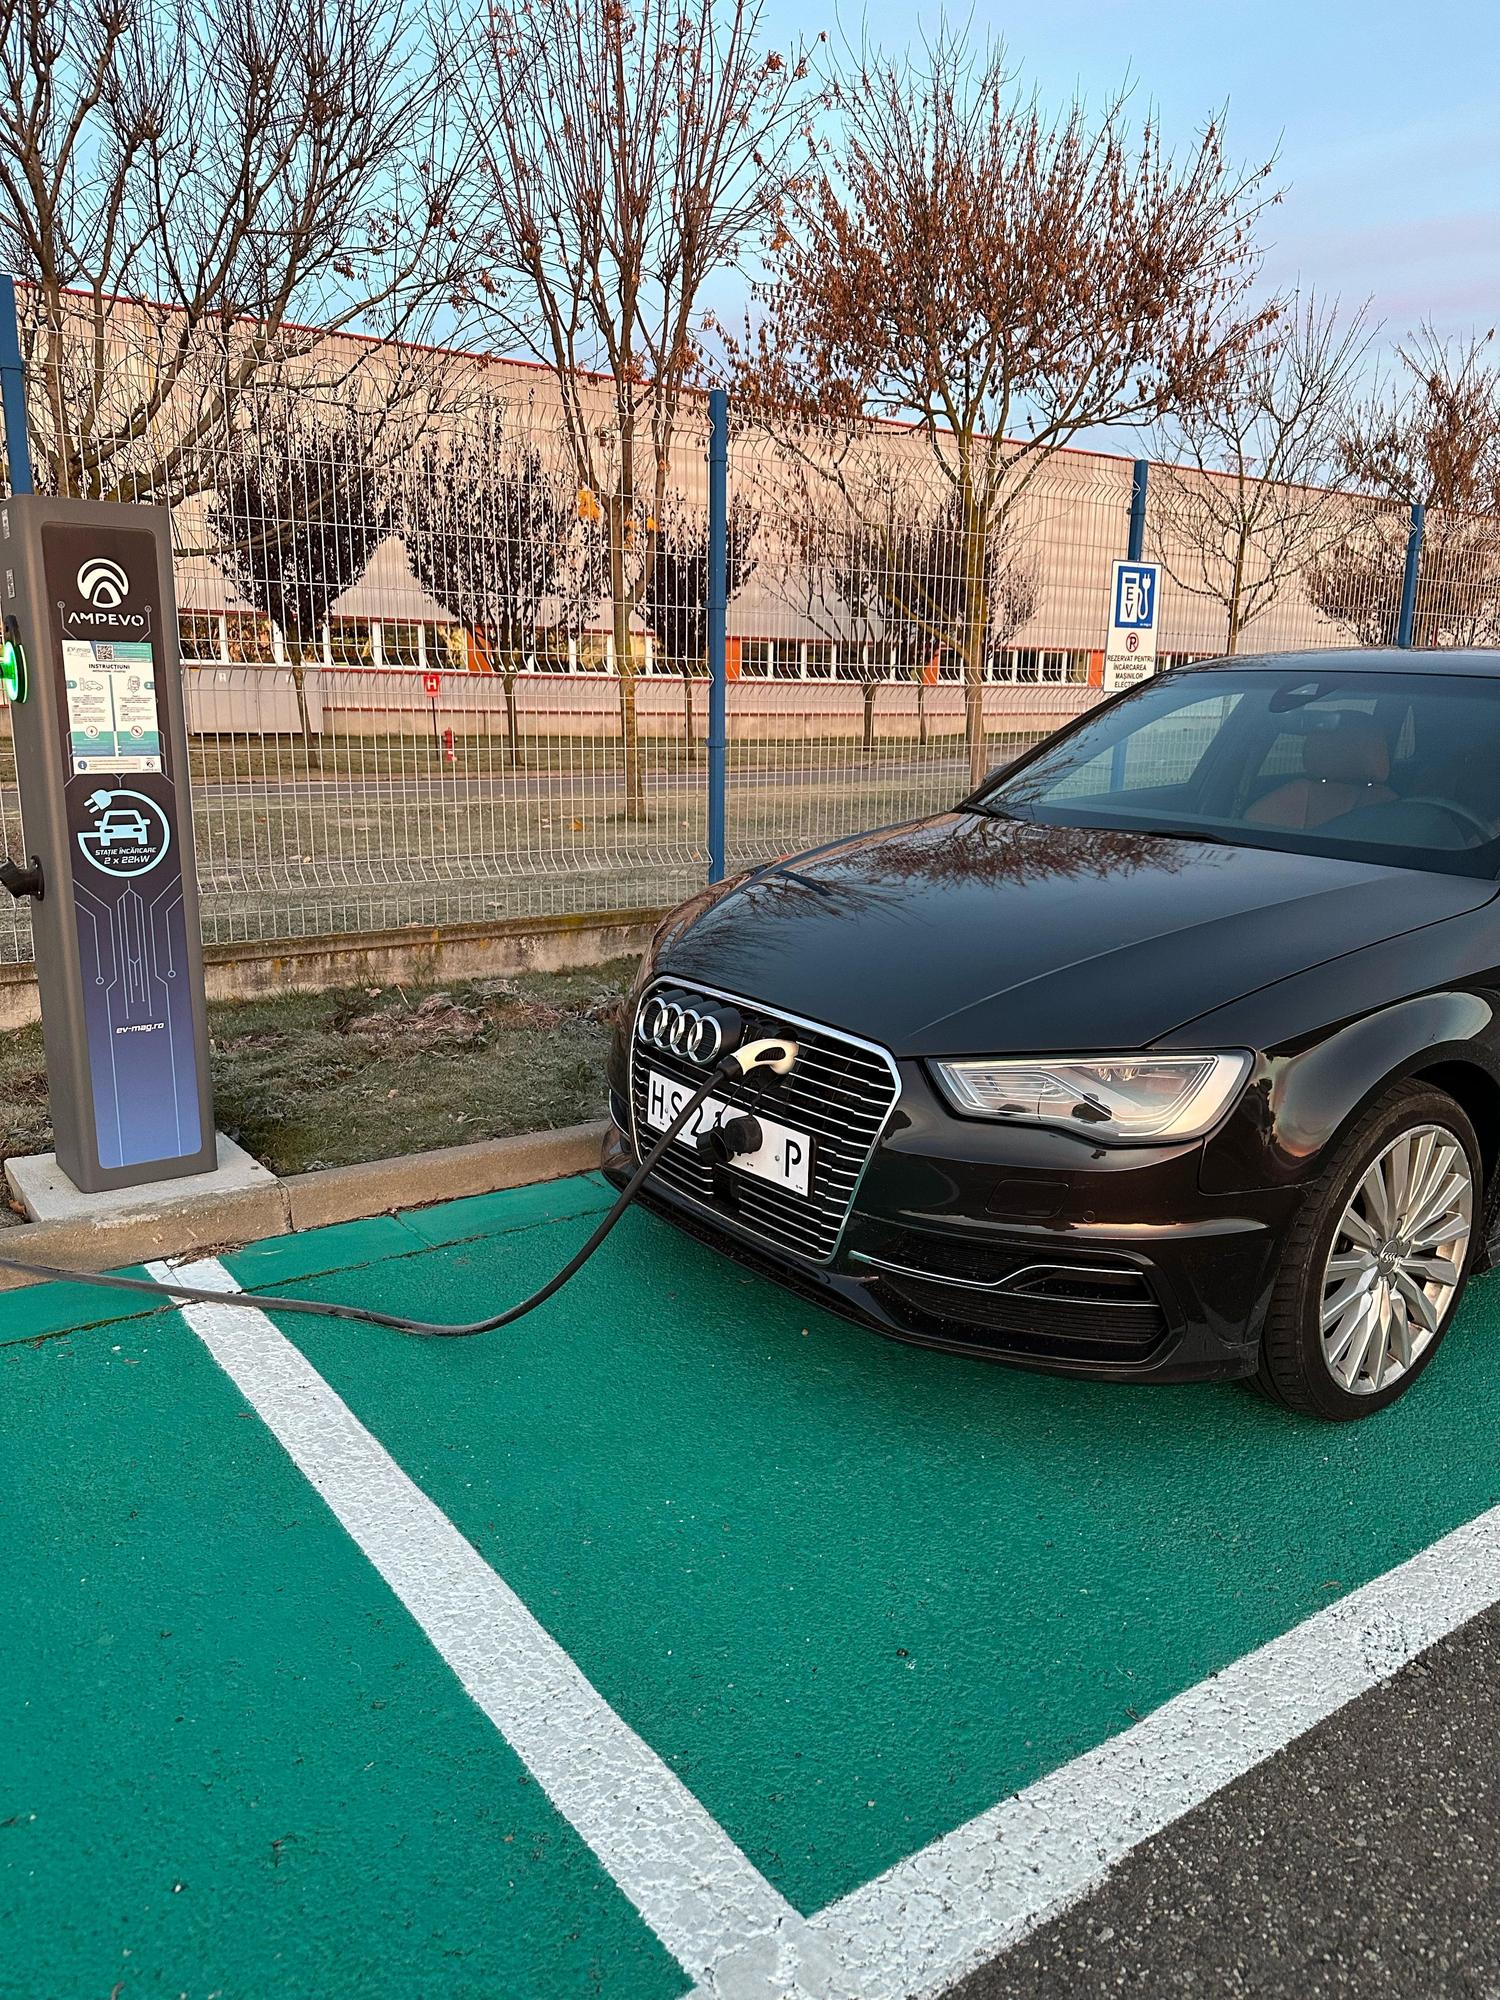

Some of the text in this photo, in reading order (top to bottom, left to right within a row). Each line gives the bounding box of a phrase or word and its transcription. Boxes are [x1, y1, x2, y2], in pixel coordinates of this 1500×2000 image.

[68, 612, 145, 627] AMPEVO
[427, 678, 437, 690] H
[118, 846, 157, 855] ÎNCĂRCARE
[104, 857, 111, 865] 2
[121, 855, 150, 864] 22kW
[116, 1022, 165, 1034] ev-mag.ro
[784, 1138, 802, 1178] P
